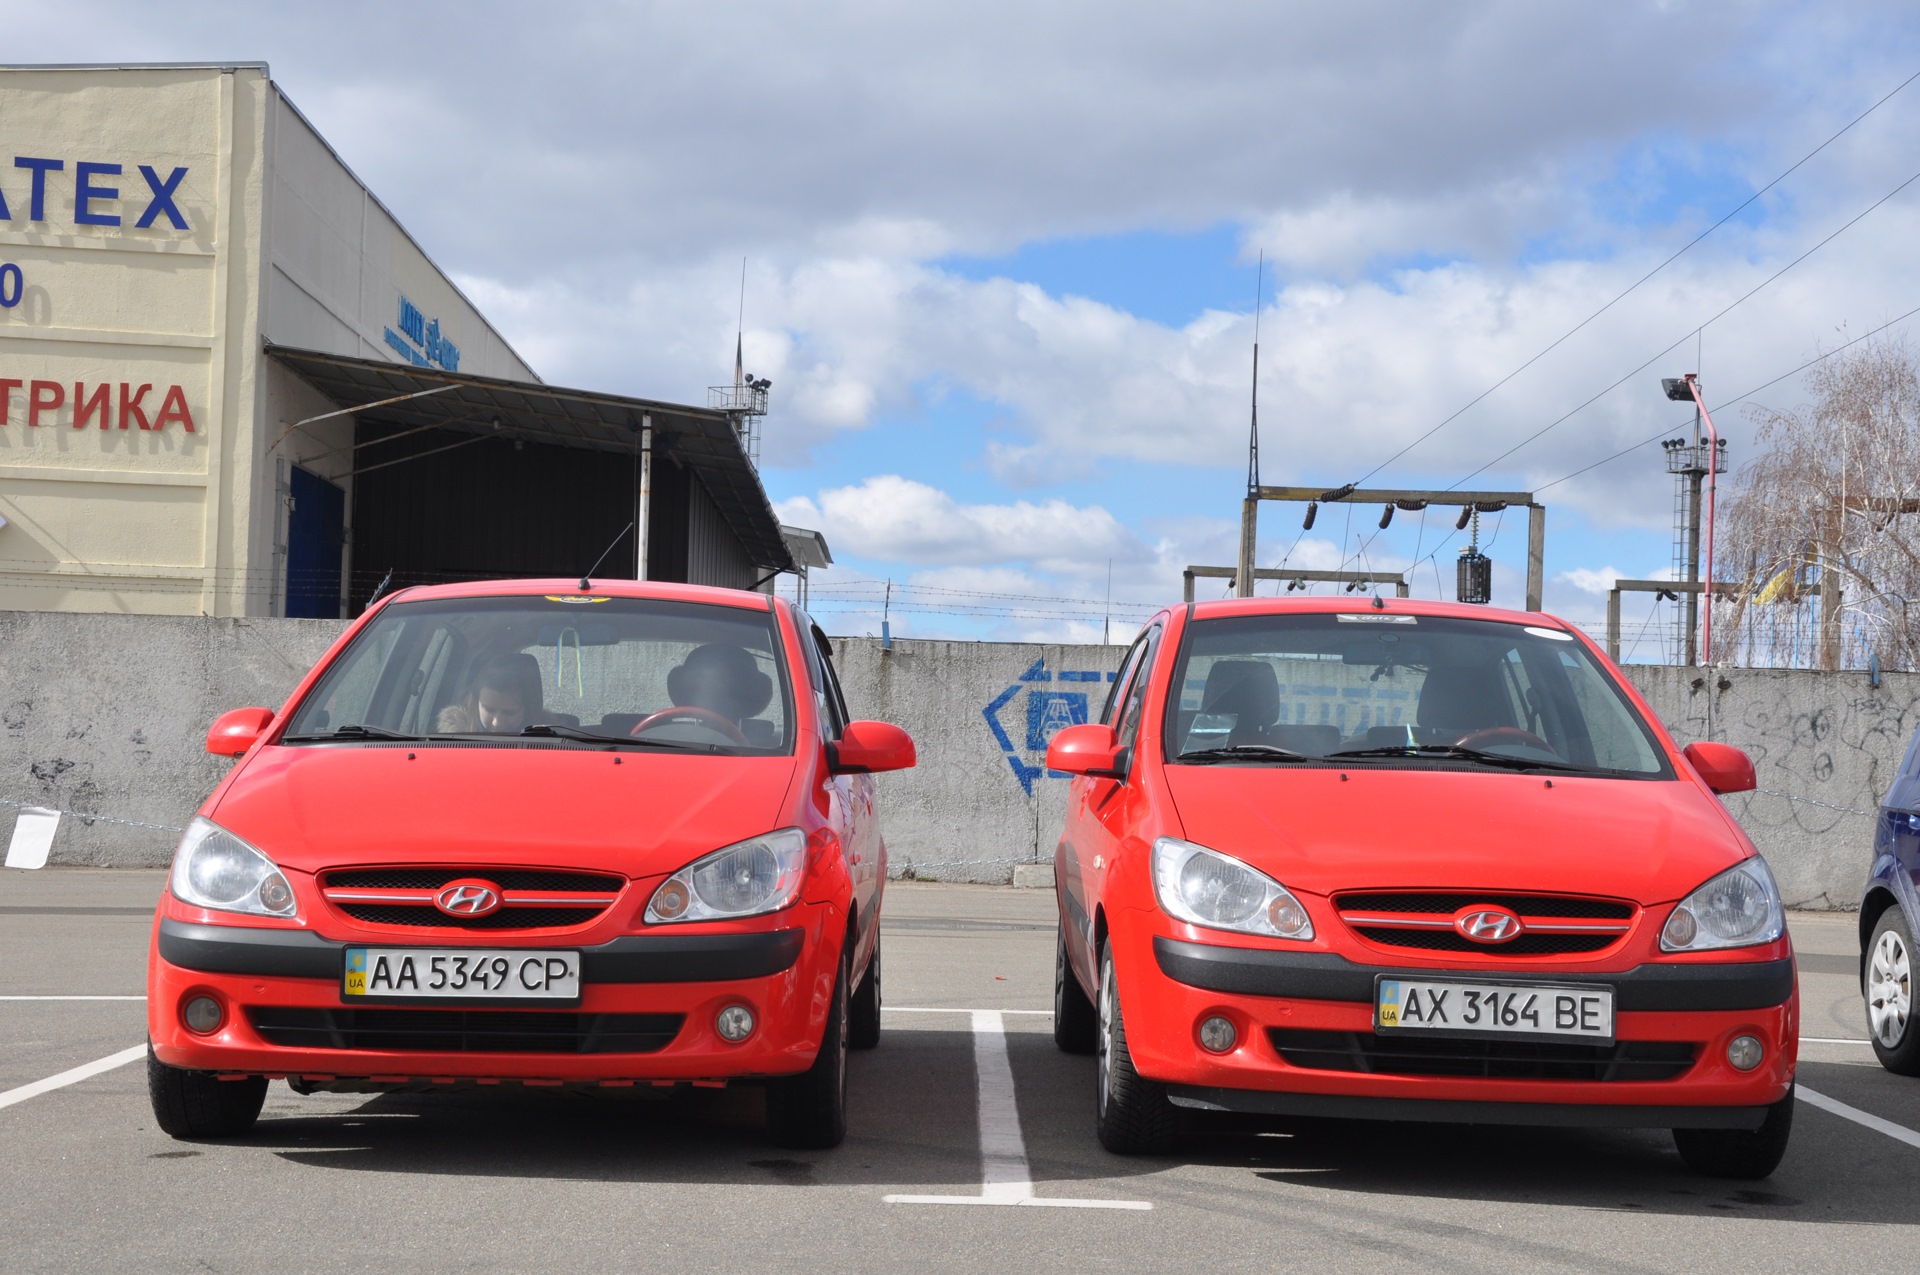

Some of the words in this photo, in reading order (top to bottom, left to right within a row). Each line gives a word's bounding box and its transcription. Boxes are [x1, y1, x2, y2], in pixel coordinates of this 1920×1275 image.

[0, 156, 190, 230] ТЕХ
[349, 978, 364, 988] UA
[370, 956, 418, 989] AA
[429, 957, 509, 990] 5349
[519, 957, 568, 990] CP
[1382, 1010, 1396, 1021] UA
[1401, 988, 1449, 1022] AX
[1463, 991, 1539, 1028] 3164
[1555, 996, 1601, 1031] BE
